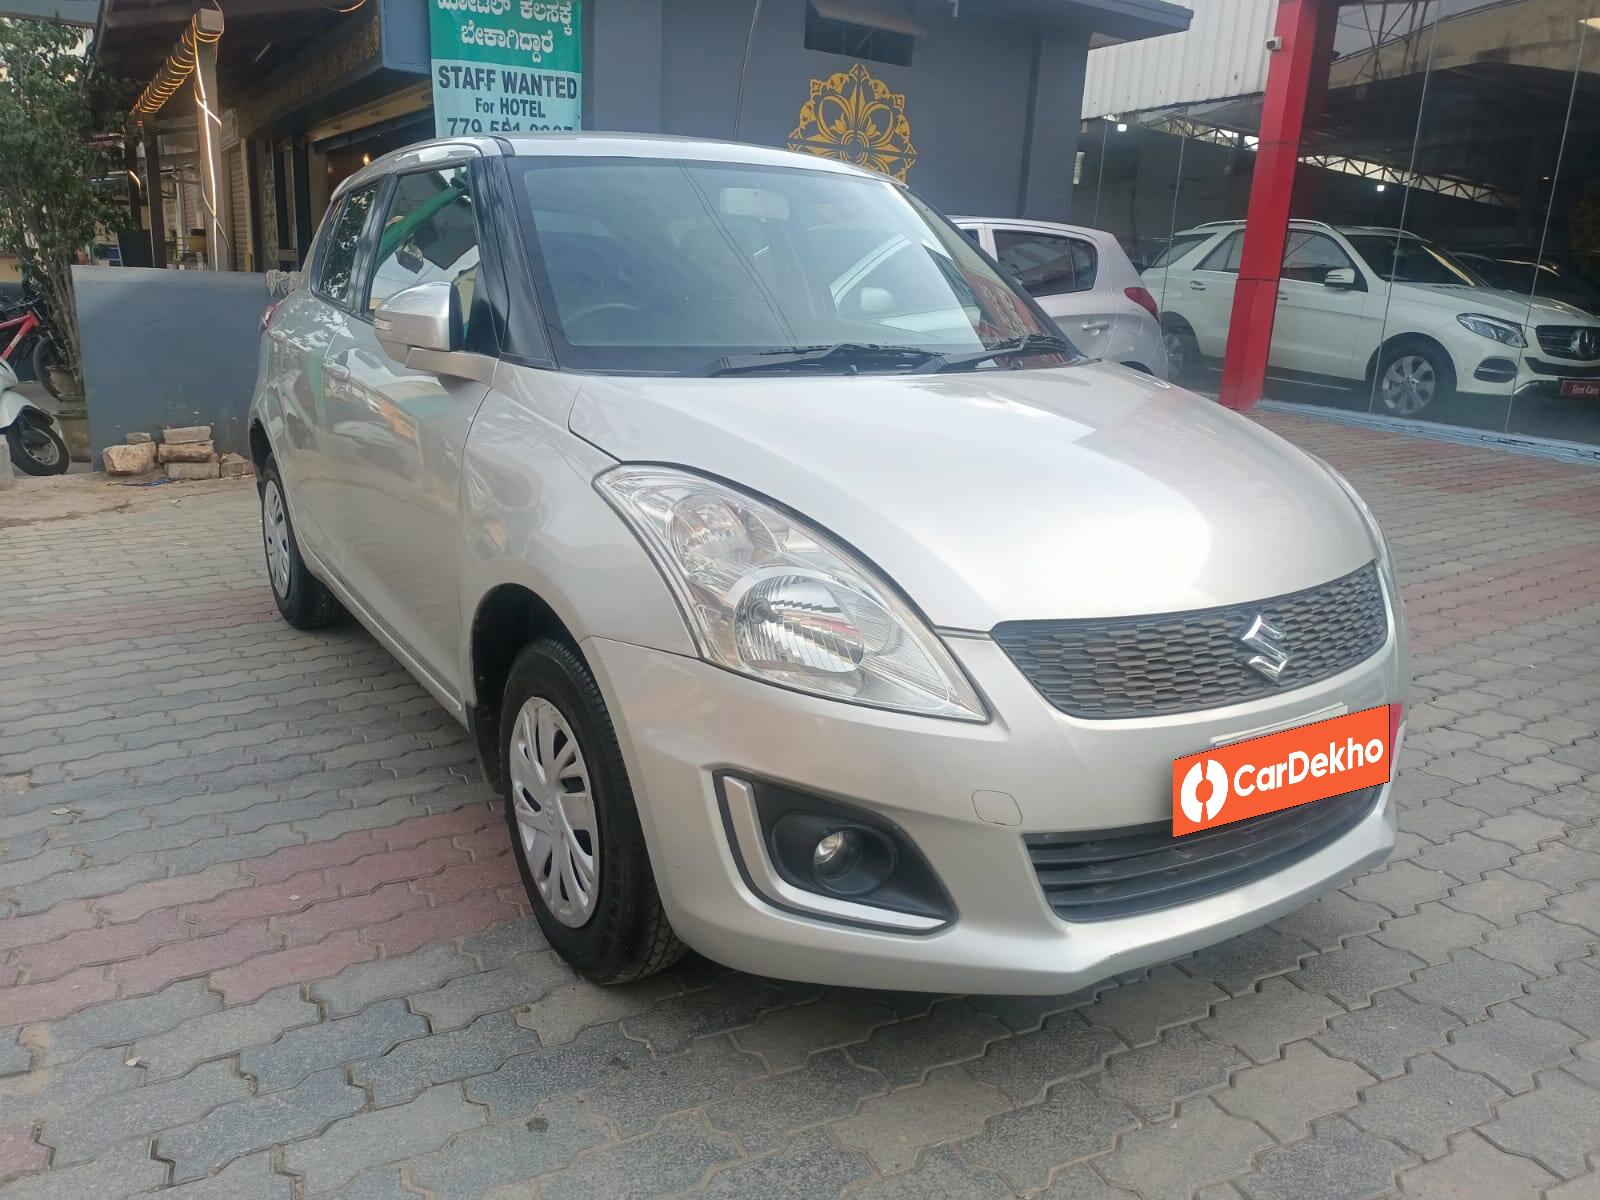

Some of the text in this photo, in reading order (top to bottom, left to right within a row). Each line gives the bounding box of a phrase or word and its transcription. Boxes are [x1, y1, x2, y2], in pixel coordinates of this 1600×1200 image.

[438, 65, 577, 100] STAFF WANTED
[475, 97, 546, 119] For HOTEL
